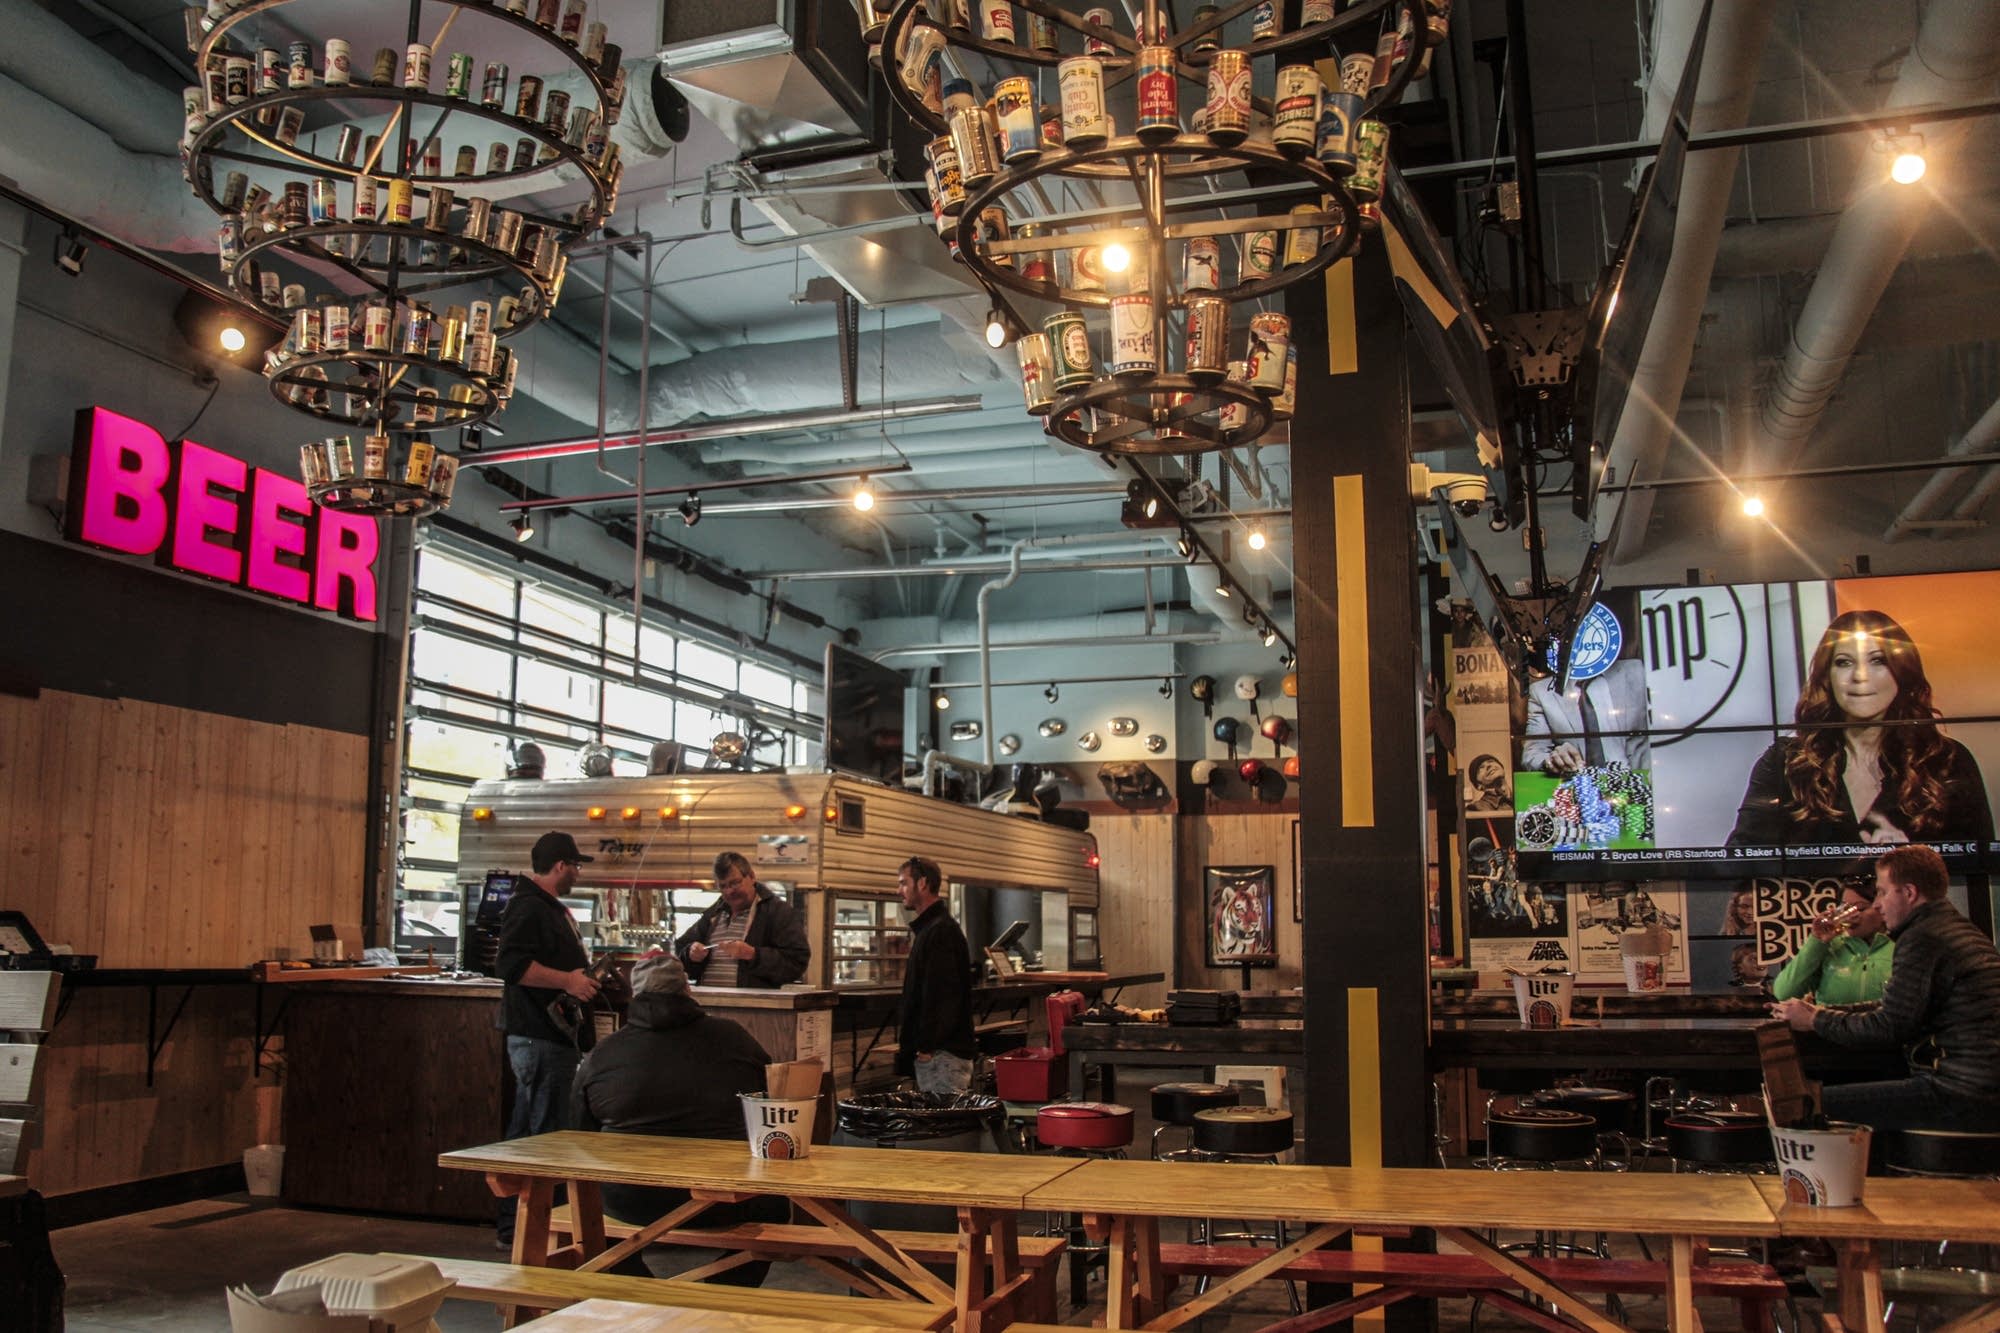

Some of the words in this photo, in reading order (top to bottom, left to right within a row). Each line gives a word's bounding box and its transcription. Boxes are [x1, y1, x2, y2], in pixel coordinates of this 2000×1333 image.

[1149, 80, 1166, 90] Dry
[1147, 90, 1169, 100] Pale
[1142, 101, 1175, 112] Tavern
[80, 405, 379, 622] BEER
[1456, 653, 1499, 674] BONA
[1552, 852, 1595, 861] HEISMAN
[1601, 852, 1610, 860] 2.
[1612, 851, 1638, 861] Bryce
[1640, 851, 1663, 860] Love
[1734, 848, 1743, 857] 3.
[1746, 847, 1773, 857] Baker
[1942, 843, 1964, 853] Falk
[1534, 940, 1563, 950] STAR
[1527, 949, 1569, 961] WARS
[1528, 980, 1559, 998] Lite
[760, 1106, 799, 1128] Lite
[1775, 1135, 1815, 1164] Lite
